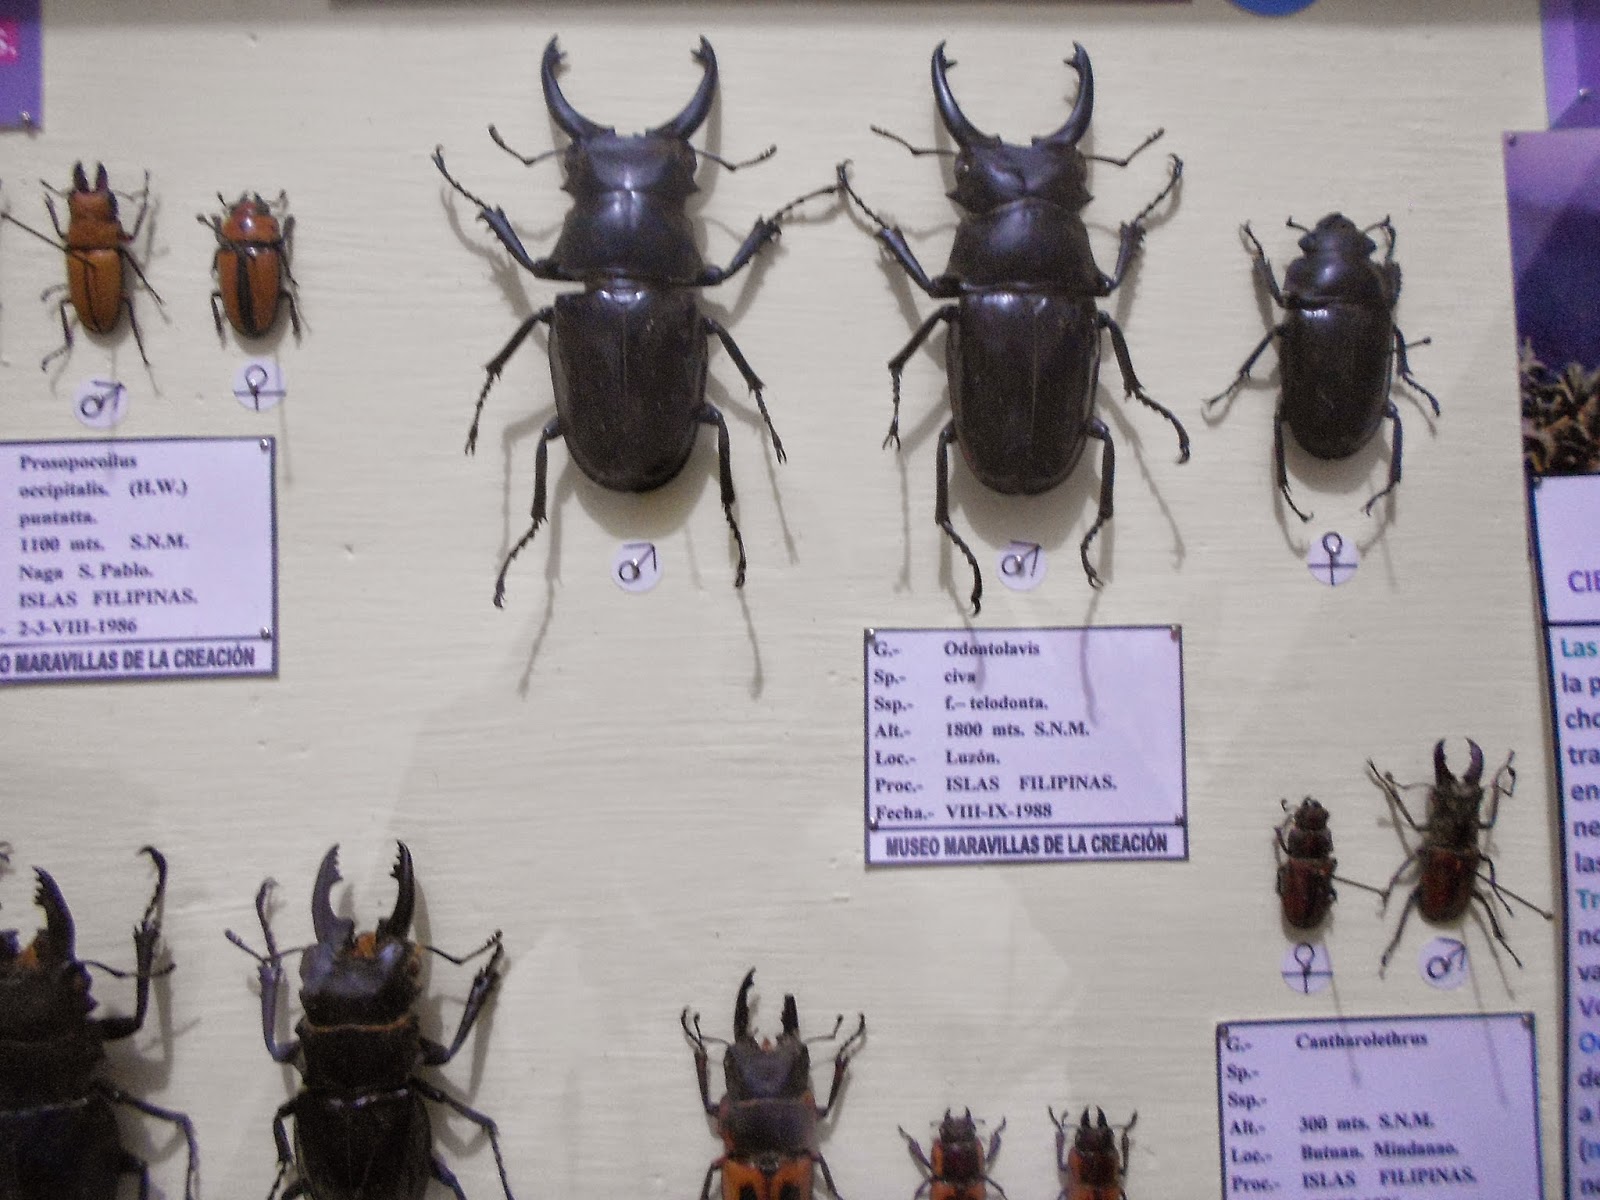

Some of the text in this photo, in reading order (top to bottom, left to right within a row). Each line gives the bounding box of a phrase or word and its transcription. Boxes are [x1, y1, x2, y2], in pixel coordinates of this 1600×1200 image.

[20, 535, 60, 552] 1100
[129, 533, 189, 550] S.N.M.
[18, 564, 64, 583] Naga
[18, 587, 198, 608] ISLAS FILIPINAS.
[943, 641, 1041, 656] Odontolavis
[1561, 638, 1597, 658] Las
[15, 651, 118, 672] MARAVILLAS
[123, 650, 144, 669] DE
[149, 649, 169, 668] LA
[173, 644, 255, 668] CREACIÓN
[943, 668, 977, 684] civa
[1561, 672, 1582, 694] la
[946, 721, 984, 737] 1800
[992, 722, 1025, 737] mts.
[1034, 721, 1090, 737] S.N.M.
[945, 749, 1001, 765] Luzón.
[946, 776, 1001, 792] ISLAS
[1019, 774, 1118, 791] FILIPINAS.
[886, 829, 1168, 857] MUSEO MARAVILLAS DE LA CREACIÓN
[1302, 1170, 1356, 1188] ISLAS
